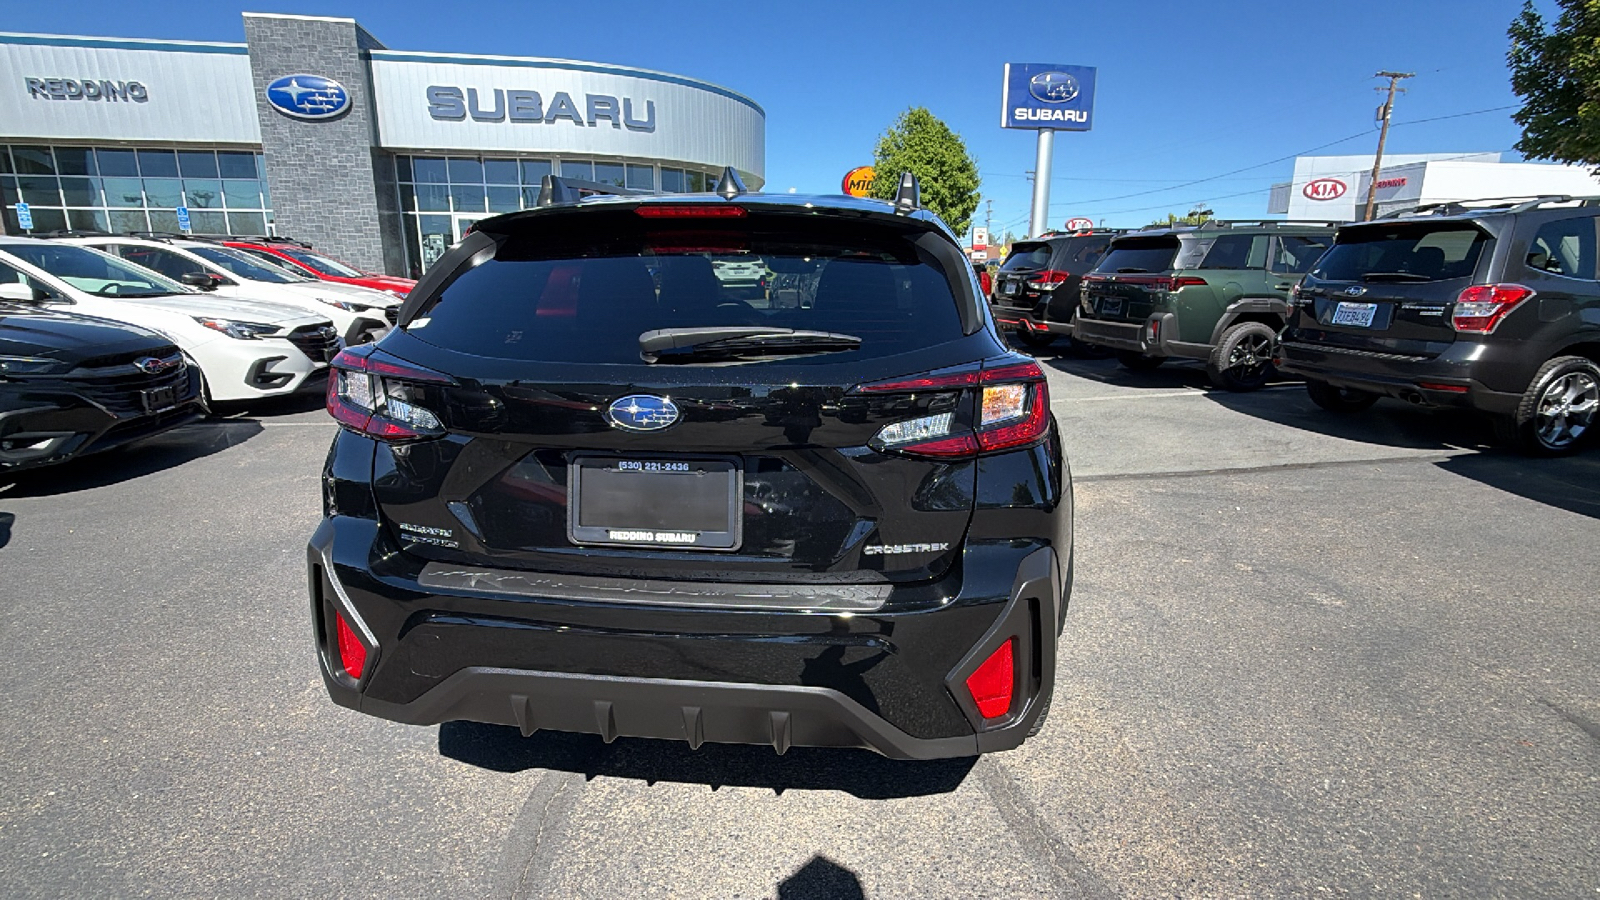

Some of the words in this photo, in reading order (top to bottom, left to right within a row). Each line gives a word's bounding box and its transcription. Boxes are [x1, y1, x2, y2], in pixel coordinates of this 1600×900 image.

[24, 77, 148, 103] REDDING
[426, 85, 656, 133] SUBARU
[1014, 107, 1088, 123] SUBARU
[1310, 183, 1339, 197] KIA
[618, 461, 642, 471] (530)
[644, 462, 689, 471] 221-2436
[609, 531, 654, 541] REDDING
[655, 532, 696, 543] SUBARU
[863, 542, 949, 556] CROSSTREK
